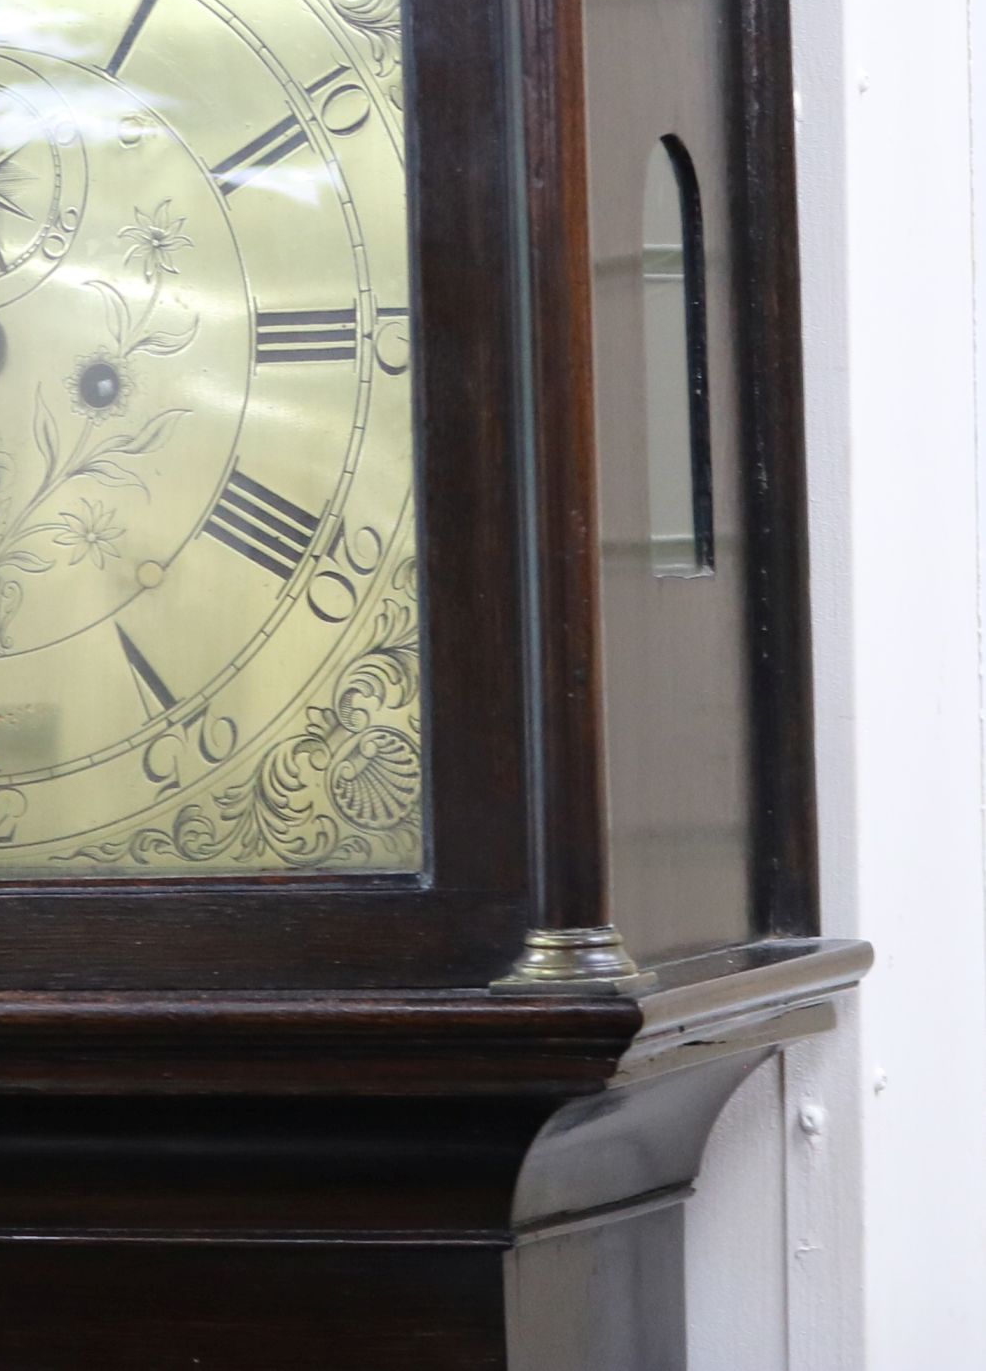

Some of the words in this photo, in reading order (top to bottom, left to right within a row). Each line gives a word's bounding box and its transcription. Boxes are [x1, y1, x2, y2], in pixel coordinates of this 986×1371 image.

[299, 65, 370, 137] 10
[199, 100, 315, 210] II
[41, 206, 79, 259] 20
[251, 296, 357, 376] III
[194, 456, 330, 600] IIII
[307, 517, 382, 623] 20
[143, 702, 238, 800] 25
